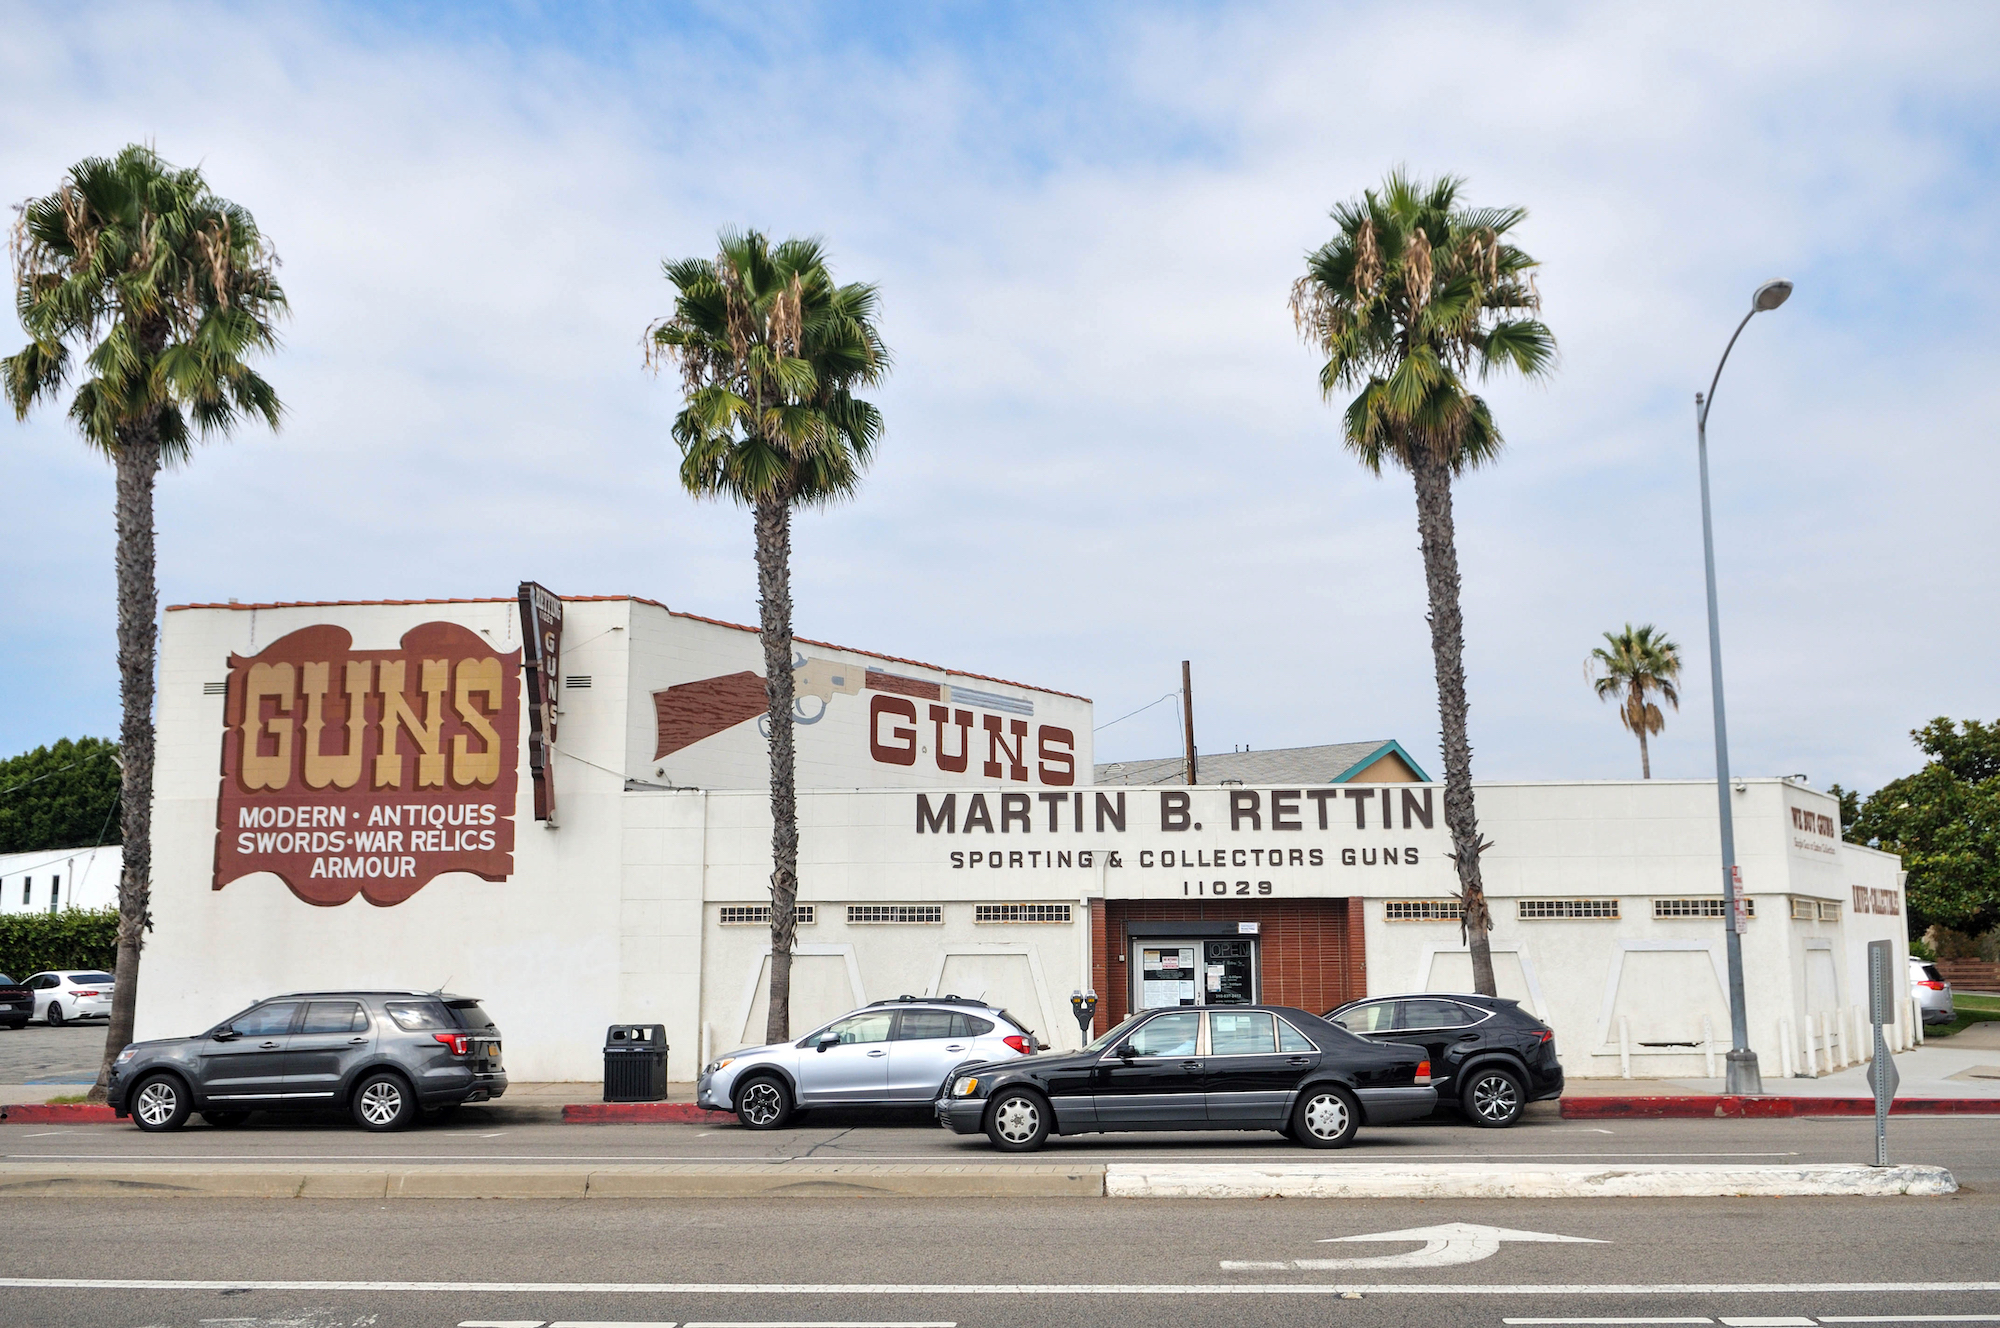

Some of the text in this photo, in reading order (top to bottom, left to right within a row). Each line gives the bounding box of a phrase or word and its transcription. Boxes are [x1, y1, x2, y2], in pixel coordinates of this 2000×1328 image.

[535, 586, 560, 620] RETTING
[544, 631, 558, 726] GUNS
[239, 656, 503, 791] GUNS
[870, 694, 1075, 787] GUNS
[238, 803, 497, 830] MODERN ANTIQUES
[916, 788, 1453, 834] MARTIN B. RETTIN
[410, 829, 496, 852] RELICS
[309, 856, 416, 879] ARMOUR
[950, 847, 1419, 869] SPORTING & COLLECTORS GUNS
[1184, 880, 1273, 896] 11029
[1211, 943, 1250, 957] OPEN
